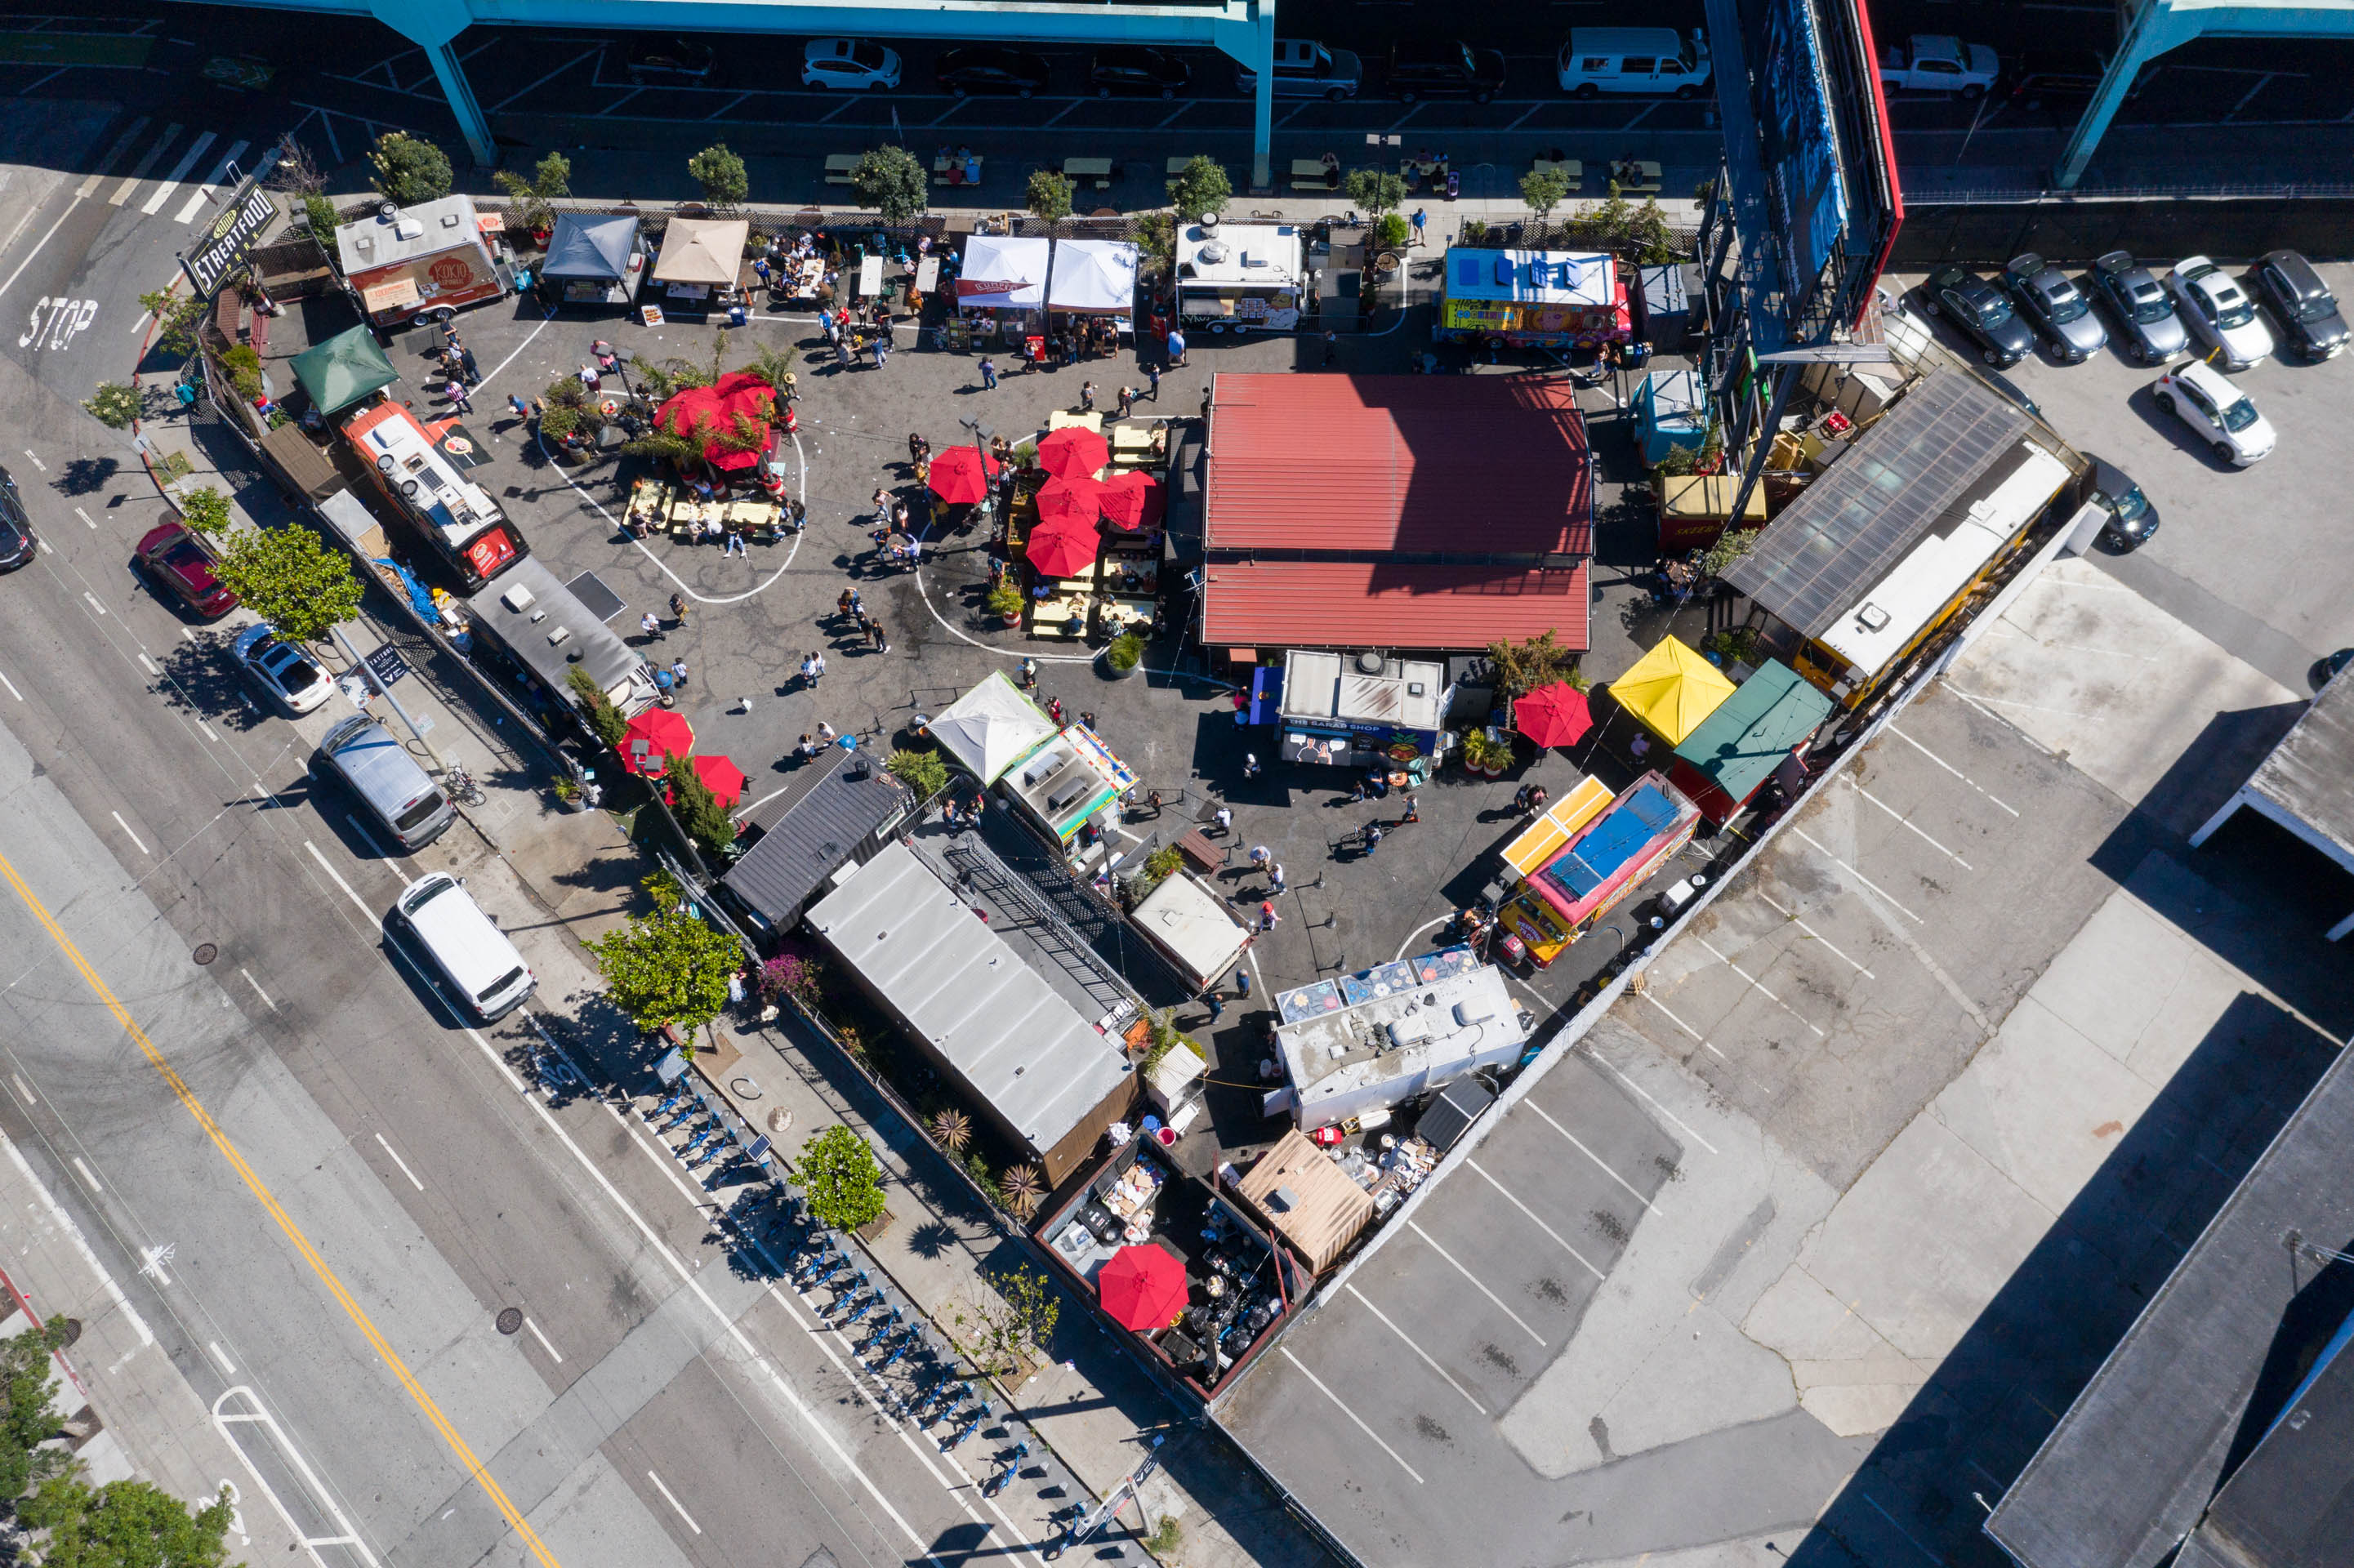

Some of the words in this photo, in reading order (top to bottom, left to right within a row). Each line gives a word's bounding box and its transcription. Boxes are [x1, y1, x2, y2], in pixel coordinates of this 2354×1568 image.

[215, 211, 236, 238] SOMA
[435, 262, 467, 278] KOKIO
[19, 296, 98, 351] STOP
[369, 646, 394, 666] TATTOOS
